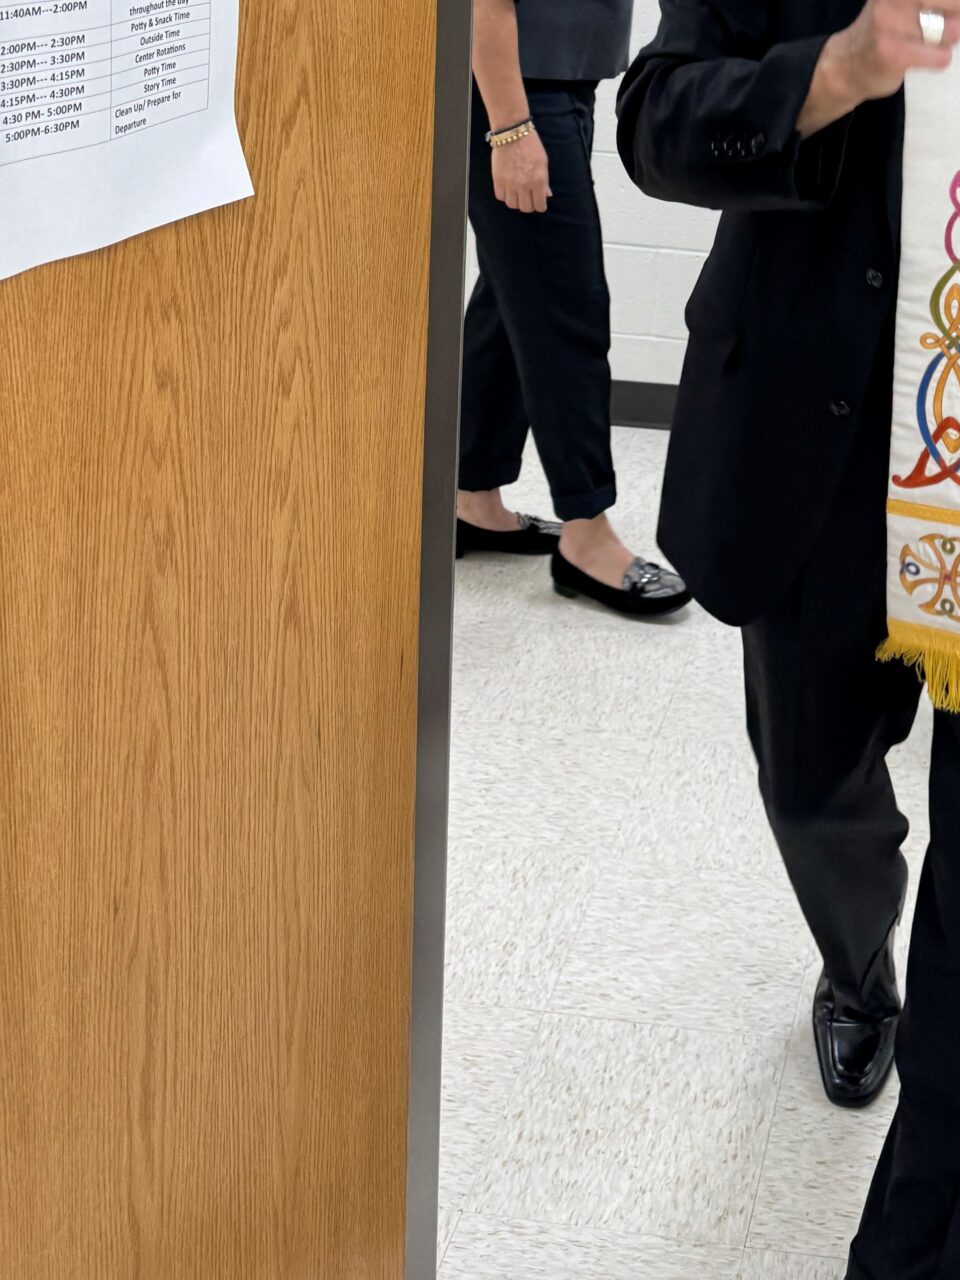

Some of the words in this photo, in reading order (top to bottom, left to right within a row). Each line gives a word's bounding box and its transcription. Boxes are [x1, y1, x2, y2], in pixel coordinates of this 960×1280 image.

[129, 0, 164, 16] throughout
[131, 22, 147, 32] Potty
[148, 18, 154, 28] &
[155, 14, 173, 26] Snack
[174, 11, 191, 21] Time
[50, 34, 86, 48] 2:30PM
[140, 32, 163, 46] Outside
[165, 29, 180, 39] Time
[50, 51, 85, 66] 3:30PM
[135, 51, 155, 64] Center
[156, 43, 186, 57] Rotations
[50, 68, 85, 82] 4:15PM
[143, 66, 160, 77] Potty
[161, 61, 176, 72] Time
[49, 85, 85, 100] 4:30PM
[143, 82, 160, 93] Story
[161, 76, 176, 87] Time
[114, 106, 133, 118] Clean
[133, 100, 146, 113] Up/
[147, 94, 171, 108] Prepare
[172, 90, 181, 100] for
[2, 113, 23, 126] 4:30
[47, 102, 82, 117] 5:00PM
[5, 119, 80, 143] 5:00PM-6:30PM
[114, 117, 147, 134] Departure
